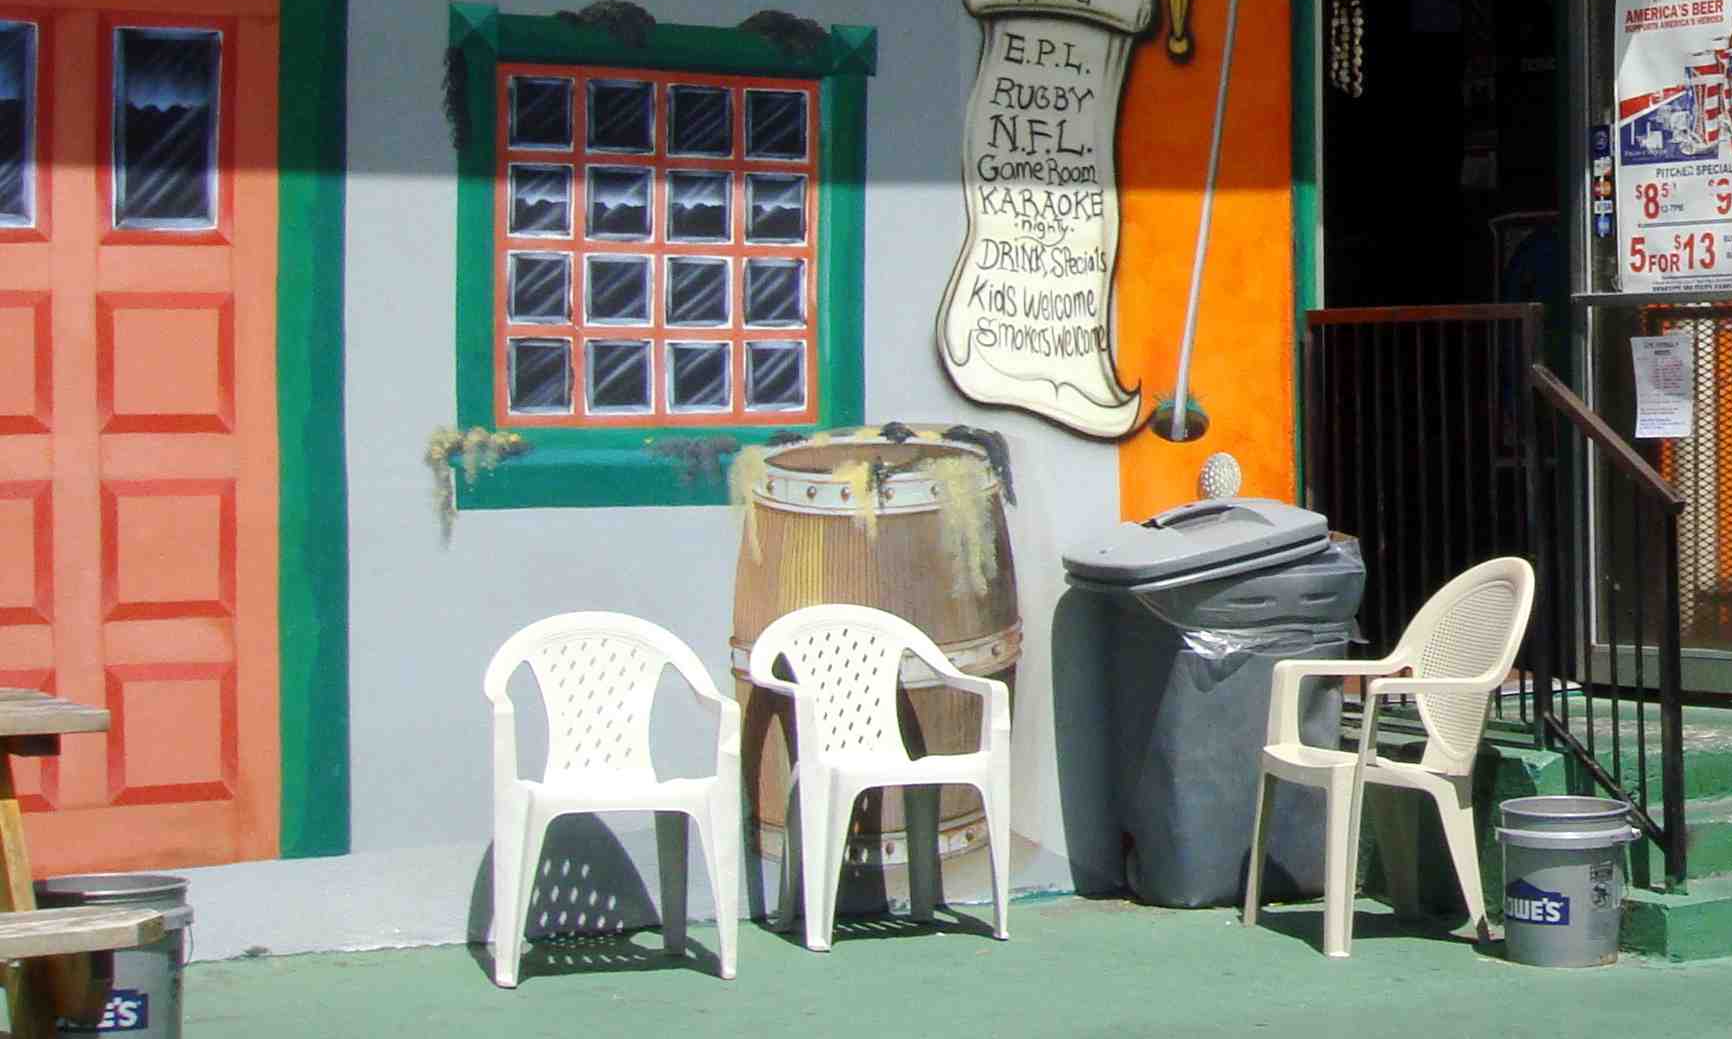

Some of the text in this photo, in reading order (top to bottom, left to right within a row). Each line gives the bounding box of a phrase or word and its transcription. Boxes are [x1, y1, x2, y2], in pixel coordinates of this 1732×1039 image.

[1625, 0, 1724, 23] AMERICA'S BEER
[1004, 32, 1090, 74] E.P.L.
[989, 77, 1094, 112] RUGBY
[987, 114, 1092, 156] N.F.L.
[977, 154, 1099, 186] Game Room
[979, 185, 1104, 221] KARAOKE
[1630, 236, 1647, 272] 5
[1648, 254, 1680, 273] FOR
[968, 275, 1017, 318] Kids
